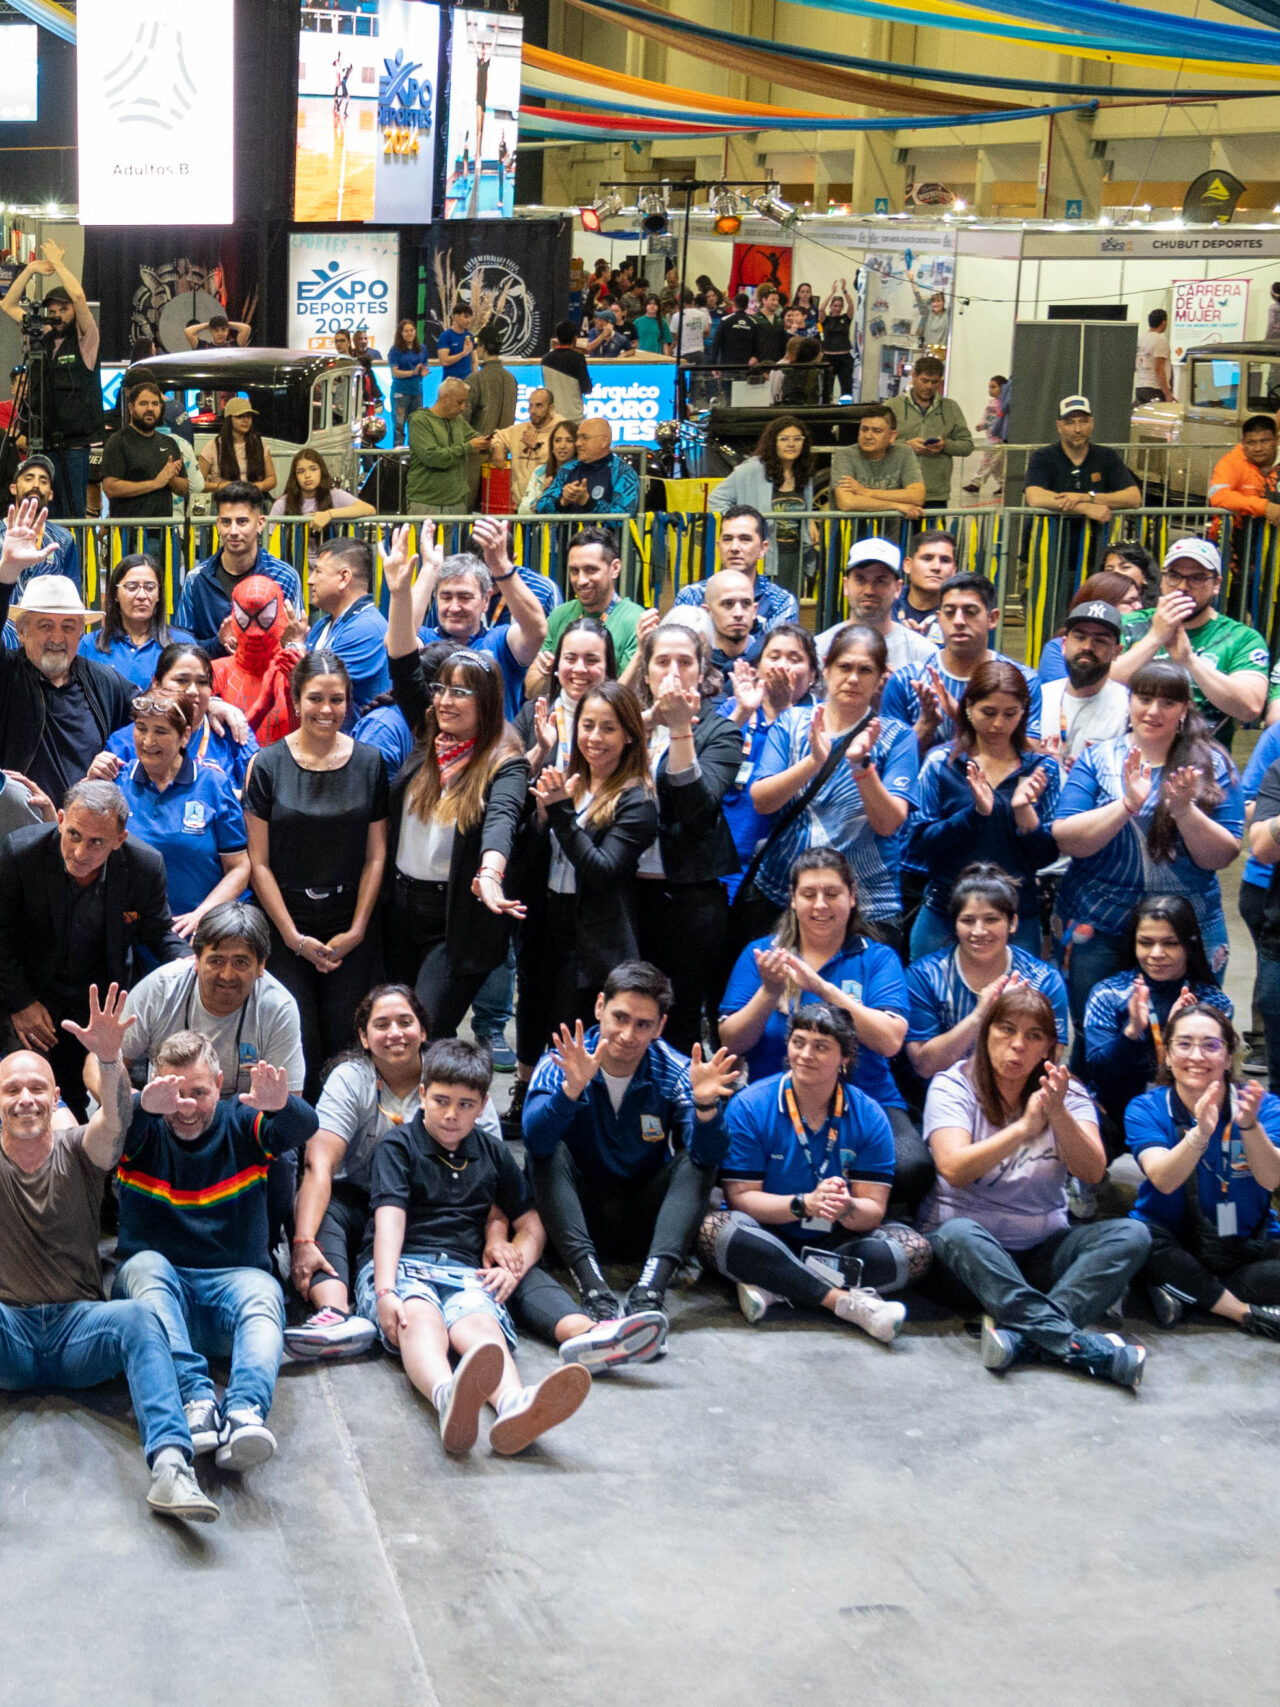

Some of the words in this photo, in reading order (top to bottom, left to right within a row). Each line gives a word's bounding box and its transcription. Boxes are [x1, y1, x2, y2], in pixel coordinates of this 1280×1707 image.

[378, 54, 432, 108] EXPO
[383, 130, 420, 154] 2024
[113, 164, 173, 176] Adultos
[180, 164, 190, 175] B
[1152, 240, 1200, 249] CHUBUT
[1202, 239, 1263, 249] DEPORTES
[297, 264, 388, 301] EXPO
[1177, 284, 1241, 297] CARRERA
[297, 302, 388, 315] DEPORTES
[1176, 297, 1193, 310] DE
[1199, 297, 1215, 309] LA
[1175, 310, 1222, 322] MUJER
[315, 318, 370, 334] 2024
